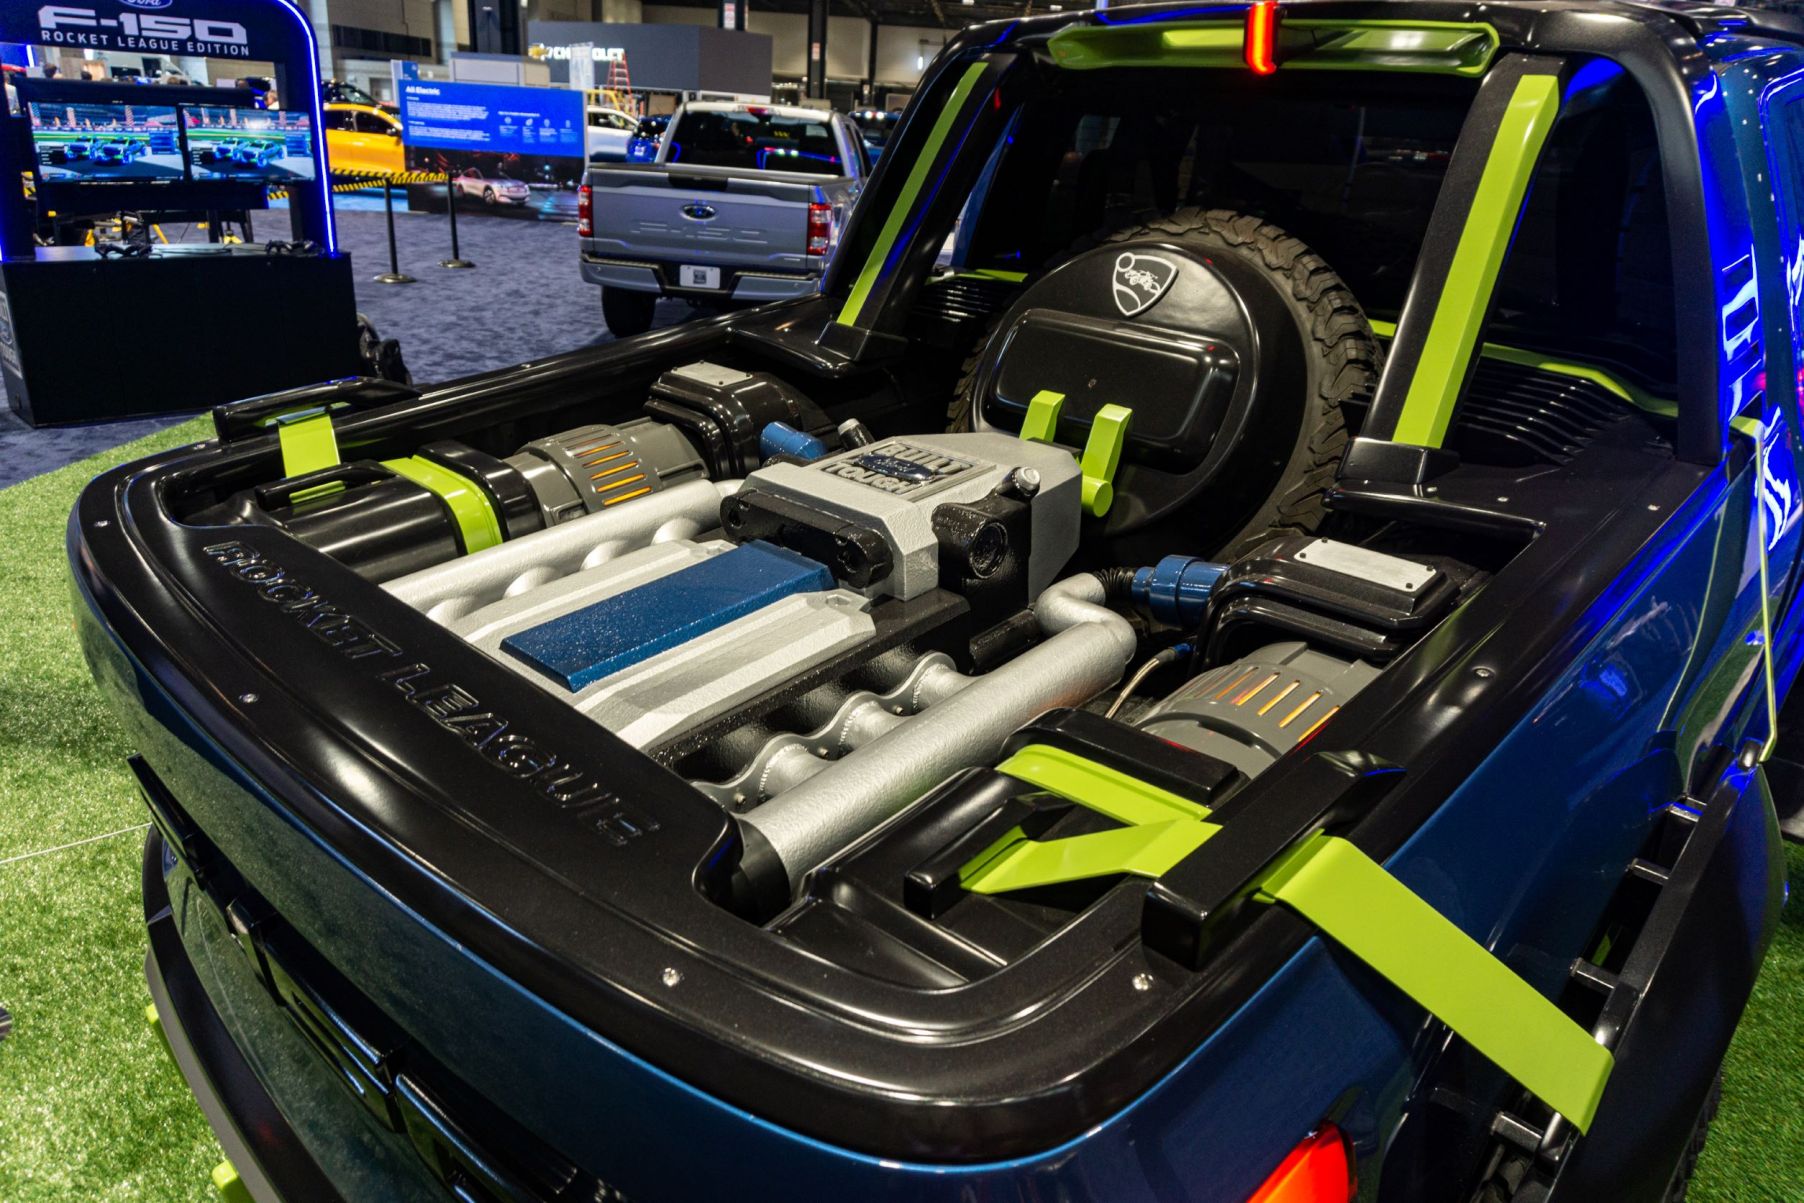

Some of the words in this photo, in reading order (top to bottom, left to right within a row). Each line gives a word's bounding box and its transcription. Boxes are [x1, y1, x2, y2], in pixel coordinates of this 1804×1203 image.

[38, 5, 248, 45] F-150
[41, 30, 109, 46] ROCKET
[117, 36, 179, 51] LEAGUE
[187, 43, 250, 56] EDITION
[553, 46, 625, 61] CHOLET
[203, 540, 404, 660] ROCKET
[376, 662, 661, 847] LEAGUE
